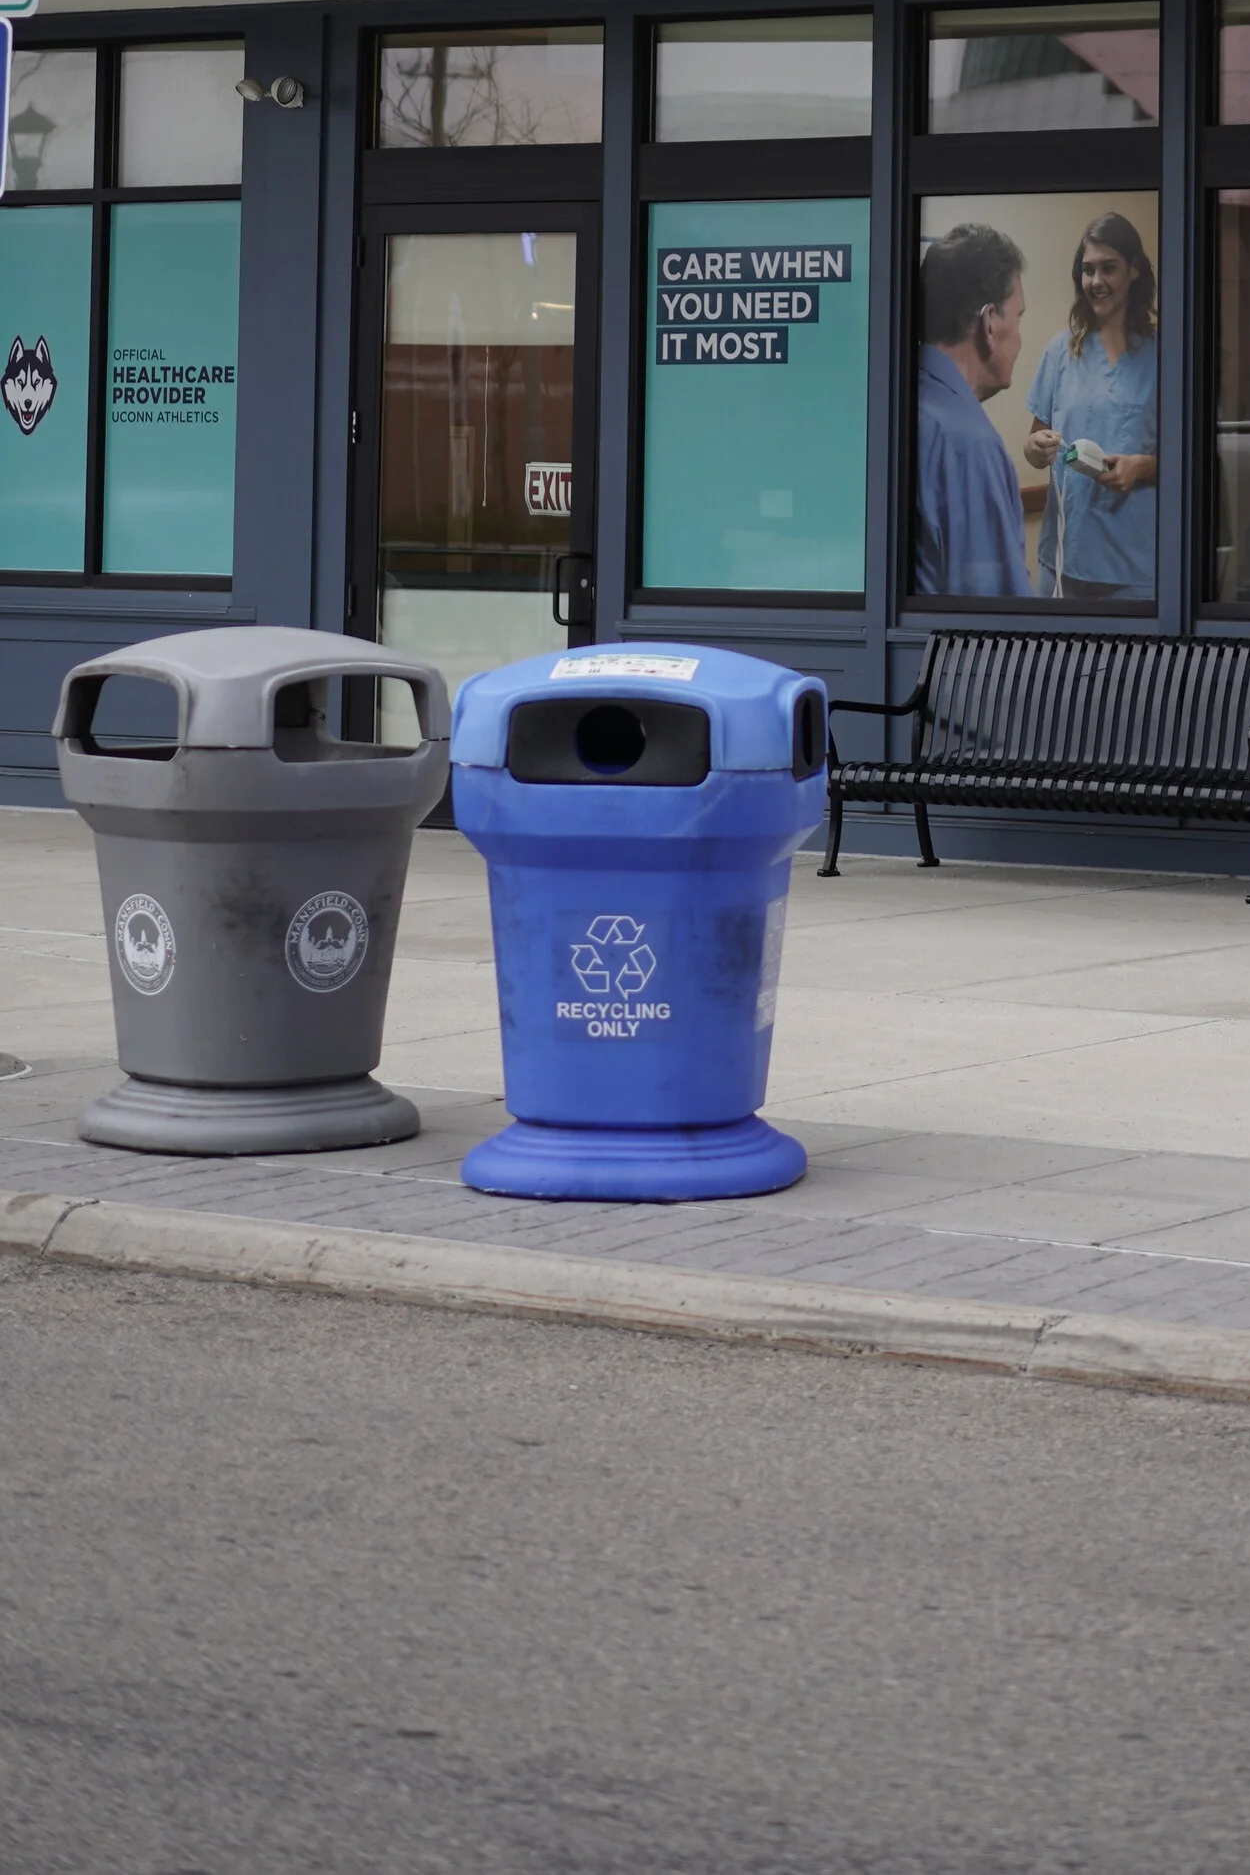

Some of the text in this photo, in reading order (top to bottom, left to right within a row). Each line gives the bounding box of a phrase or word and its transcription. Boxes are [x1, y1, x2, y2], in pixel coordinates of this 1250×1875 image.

[662, 250, 844, 281] CARE WHEN
[662, 291, 812, 321] YOU NEED
[113, 349, 166, 361] OFFICIAL
[662, 331, 782, 361] IT MOST.
[113, 366, 235, 384] HEALTHCARE
[112, 387, 206, 405] PROVIDER
[111, 411, 219, 423] UCONN ATHLETICS
[529, 471, 572, 511] EXIT
[118, 898, 156, 942] MANSFIELD
[290, 895, 349, 944] MANSFIELD
[556, 1002, 671, 1020] RECYCLING
[587, 1020, 640, 1037] ONLY
